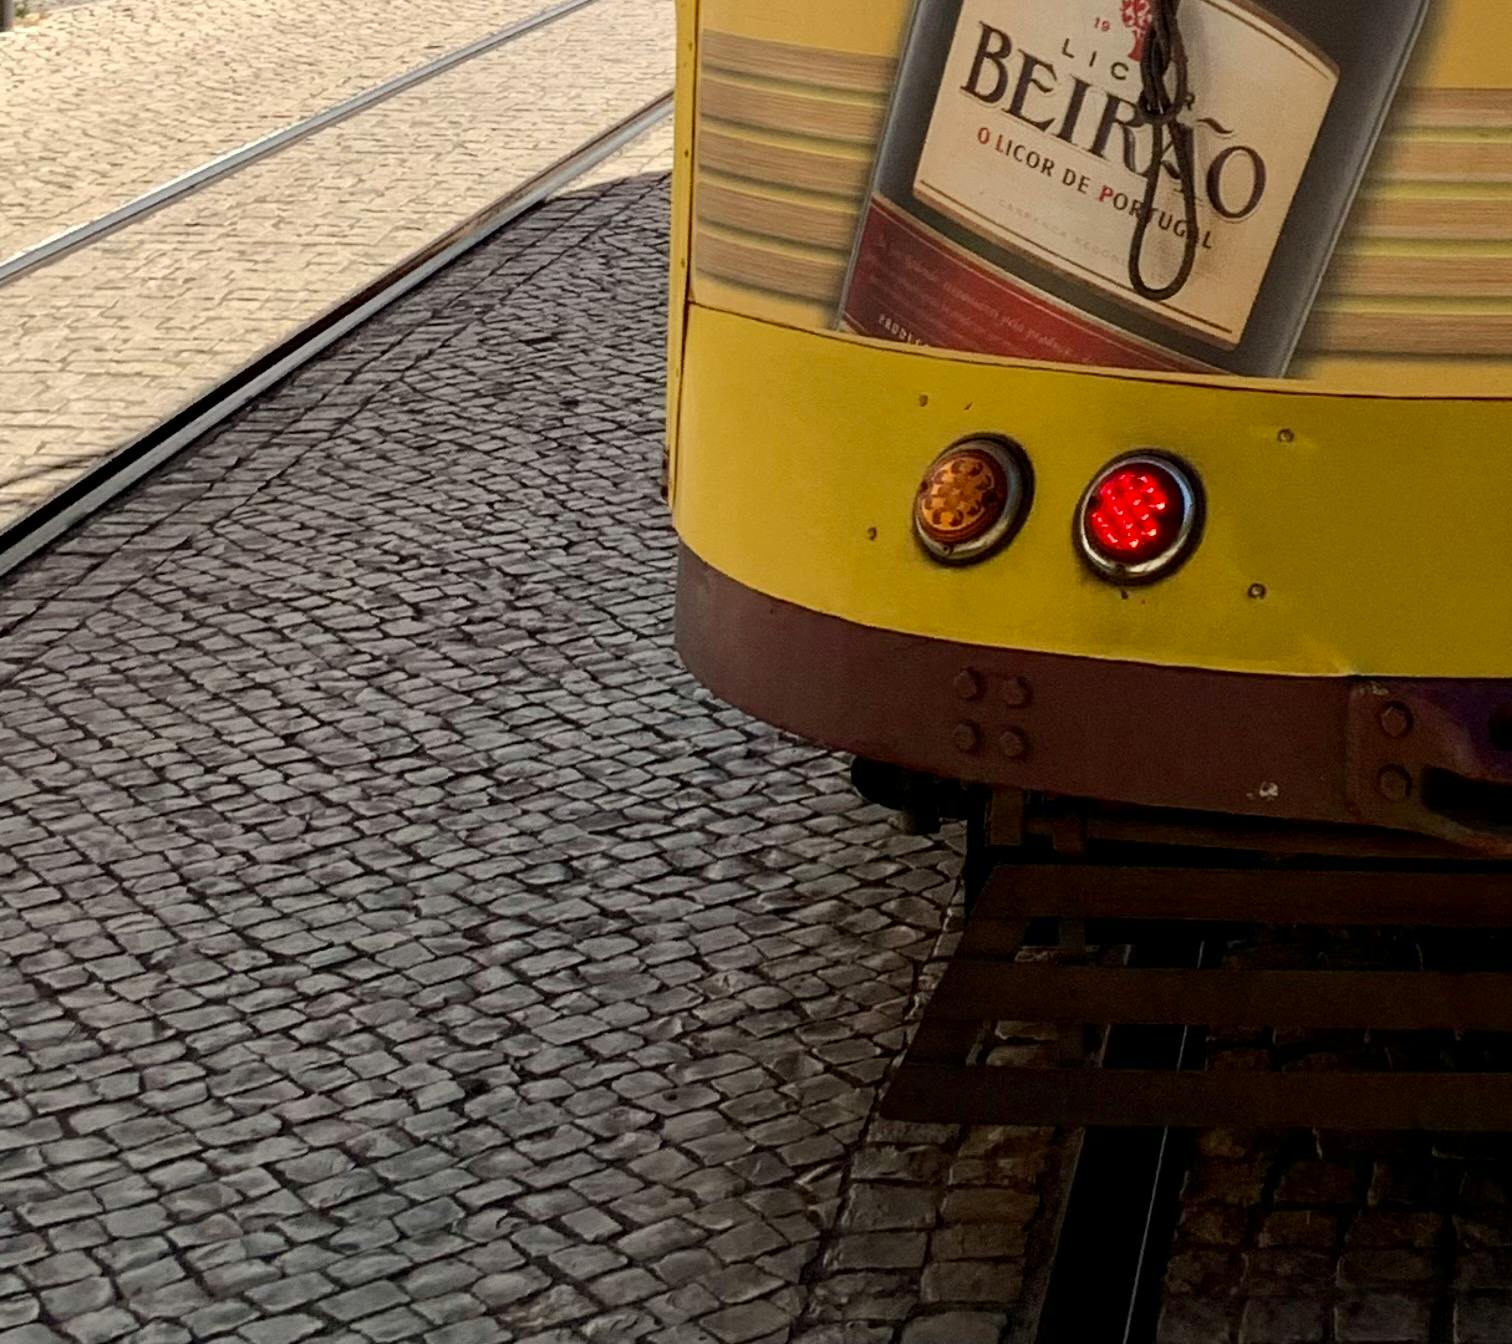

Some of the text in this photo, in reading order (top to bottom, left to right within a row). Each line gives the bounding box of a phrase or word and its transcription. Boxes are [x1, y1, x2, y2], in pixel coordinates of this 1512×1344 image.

[1062, 37, 1196, 111] LICR
[977, 127, 991, 145] O
[996, 134, 1055, 178] LICOR
[1062, 168, 1091, 194] DE
